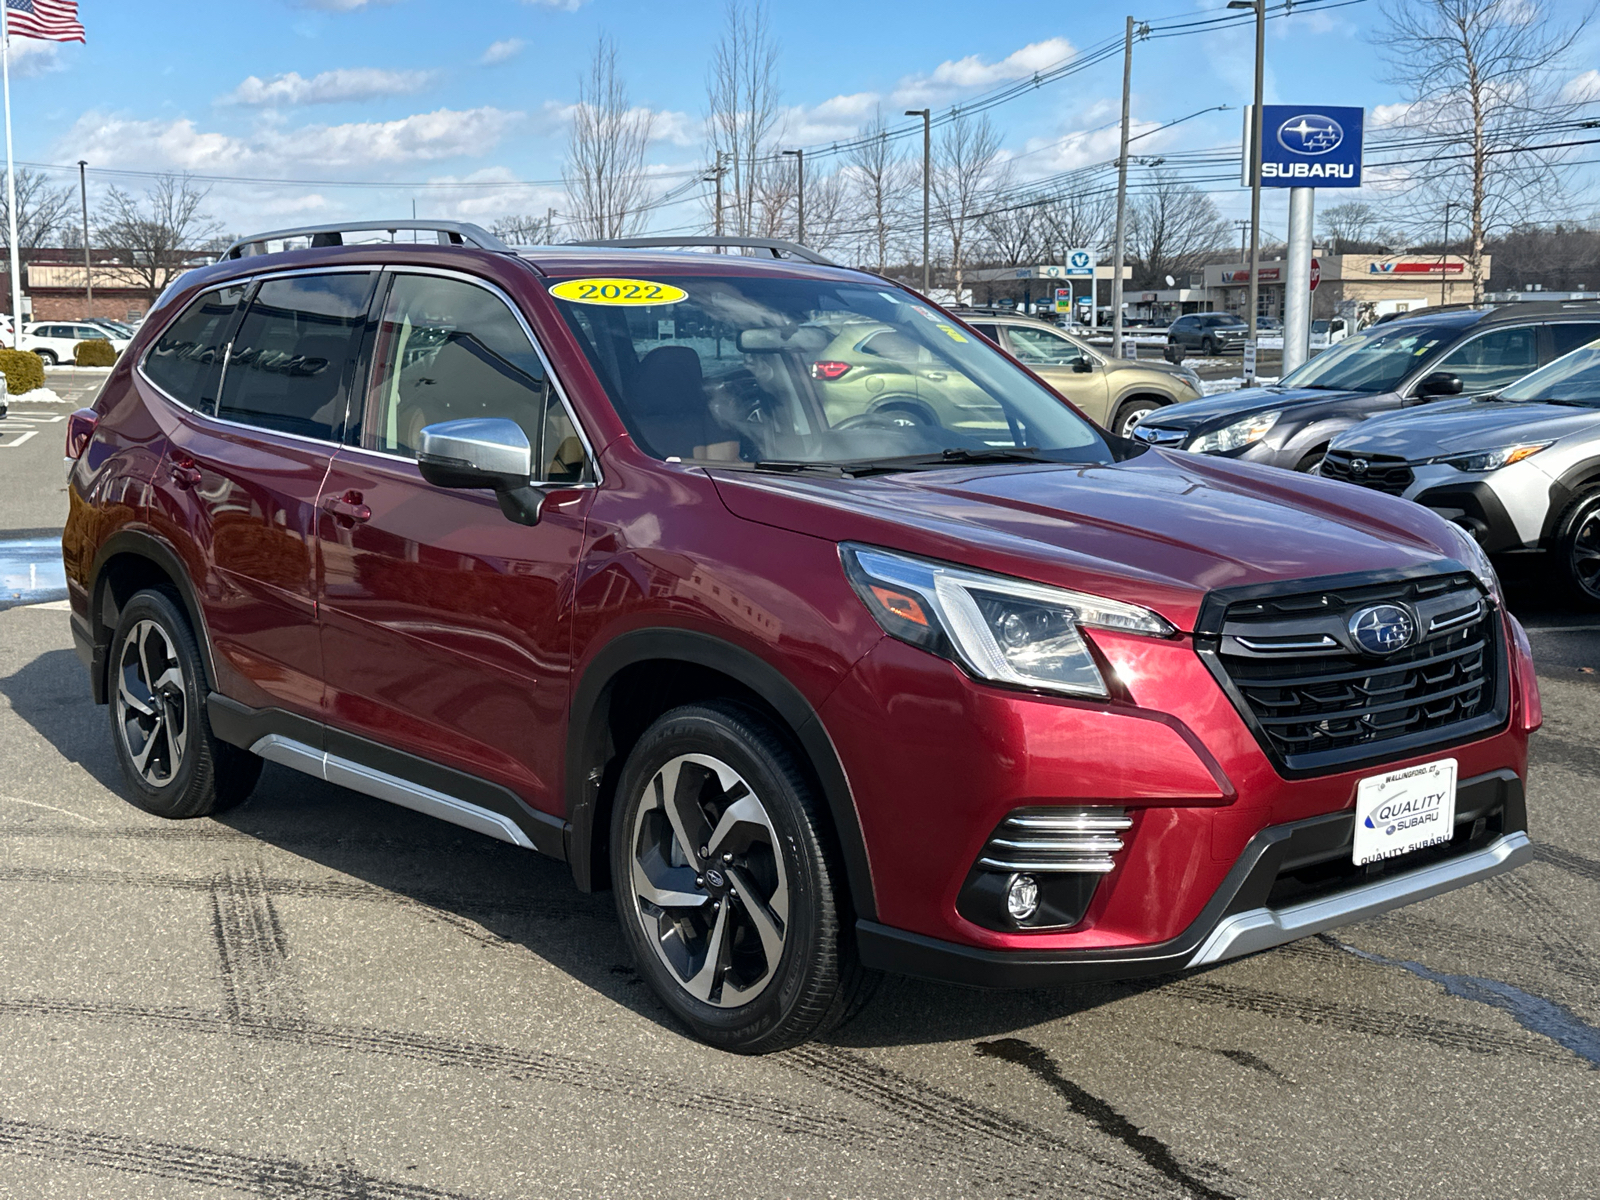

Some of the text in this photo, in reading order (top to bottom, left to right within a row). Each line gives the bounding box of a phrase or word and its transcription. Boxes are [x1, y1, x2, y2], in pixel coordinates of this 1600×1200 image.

[1261, 162, 1354, 178] SUBARU
[578, 284, 664, 299] 2022
[1379, 791, 1446, 820] QUALITY
[1397, 812, 1439, 831] SUBARU
[1361, 834, 1450, 865] QUALITY SUBARU
